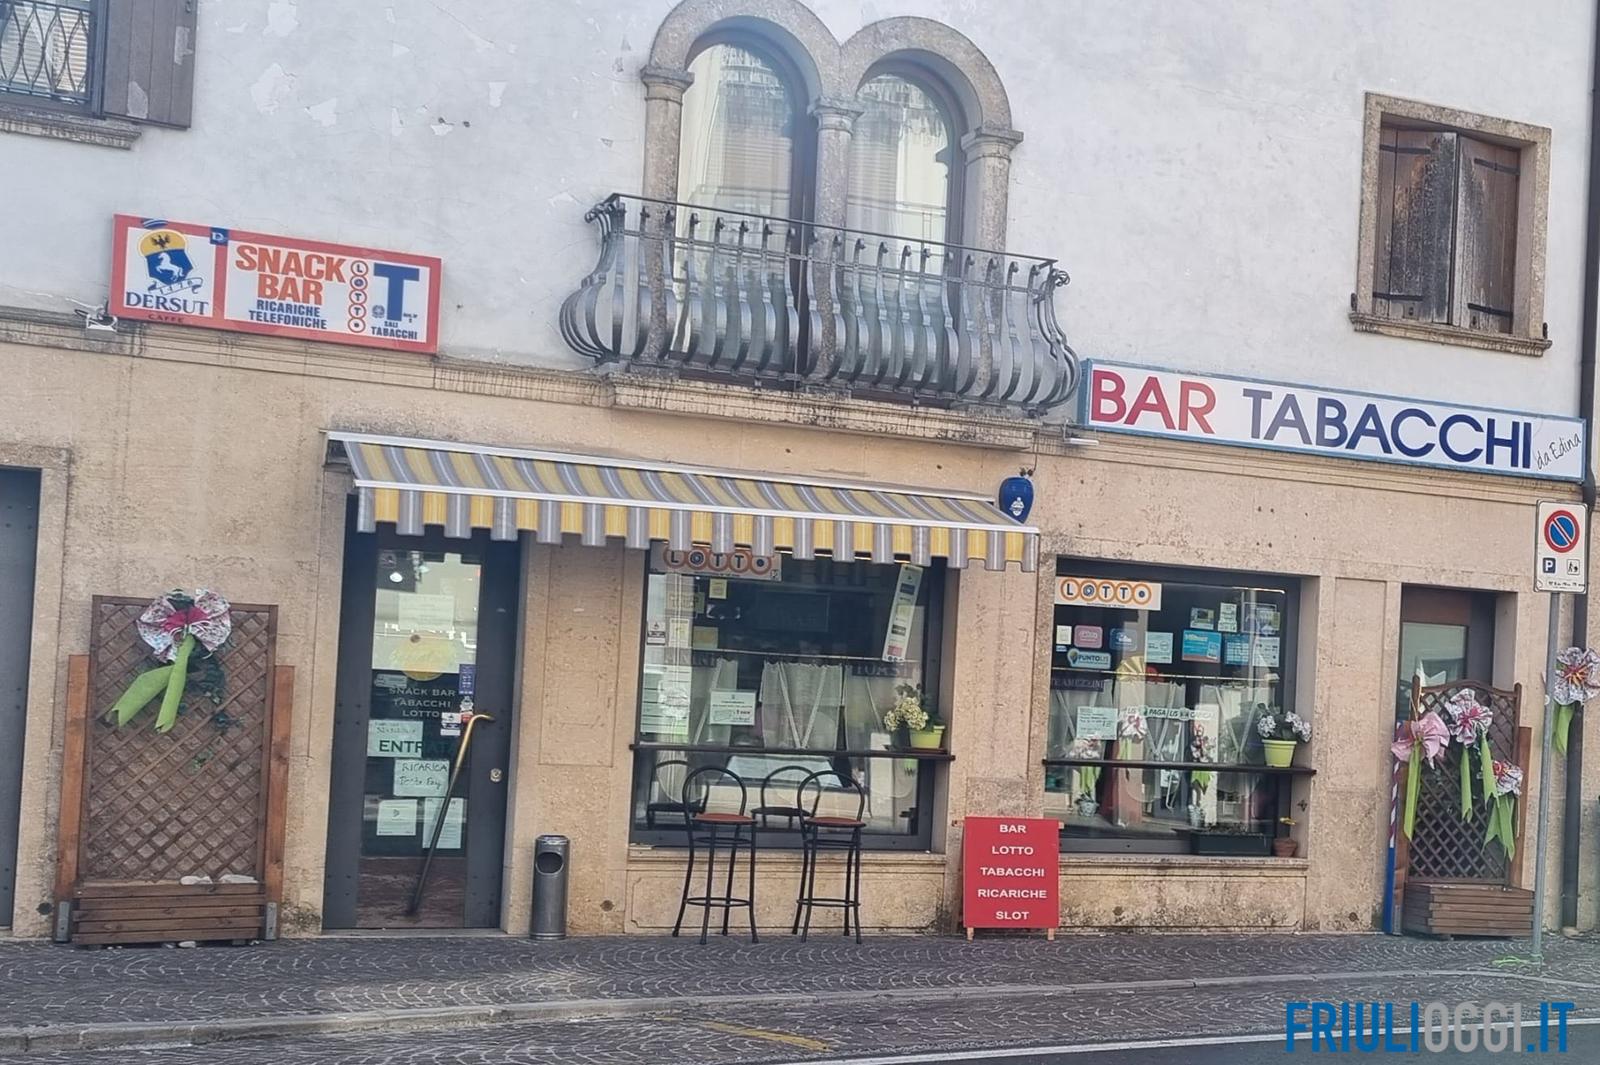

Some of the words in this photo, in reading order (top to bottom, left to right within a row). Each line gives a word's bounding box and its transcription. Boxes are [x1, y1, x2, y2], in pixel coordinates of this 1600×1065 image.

[235, 245, 346, 283] SNACK
[257, 273, 323, 305] BAR
[374, 262, 420, 322] T
[125, 291, 209, 315] DERSUT
[256, 299, 321, 318] RICARICHE
[248, 310, 328, 330] TELEFONICHE
[371, 326, 418, 341] TABACCHI
[1091, 369, 1216, 435] BAR
[1242, 388, 1533, 470] TABACCHI
[1549, 432, 1582, 460] Edina
[667, 547, 769, 573] LOTTO
[1063, 581, 1149, 602] LOTTO
[389, 687, 428, 696] SNACK
[432, 689, 456, 697] BAR
[394, 699, 451, 708] TABACCHI
[402, 710, 440, 718] LOTTO
[1000, 824, 1027, 833] BAR
[991, 845, 1034, 855] LOTTO
[980, 867, 1045, 877] TABACCHI
[977, 888, 1047, 899] RICARICHE
[995, 911, 1030, 920] SLOT
